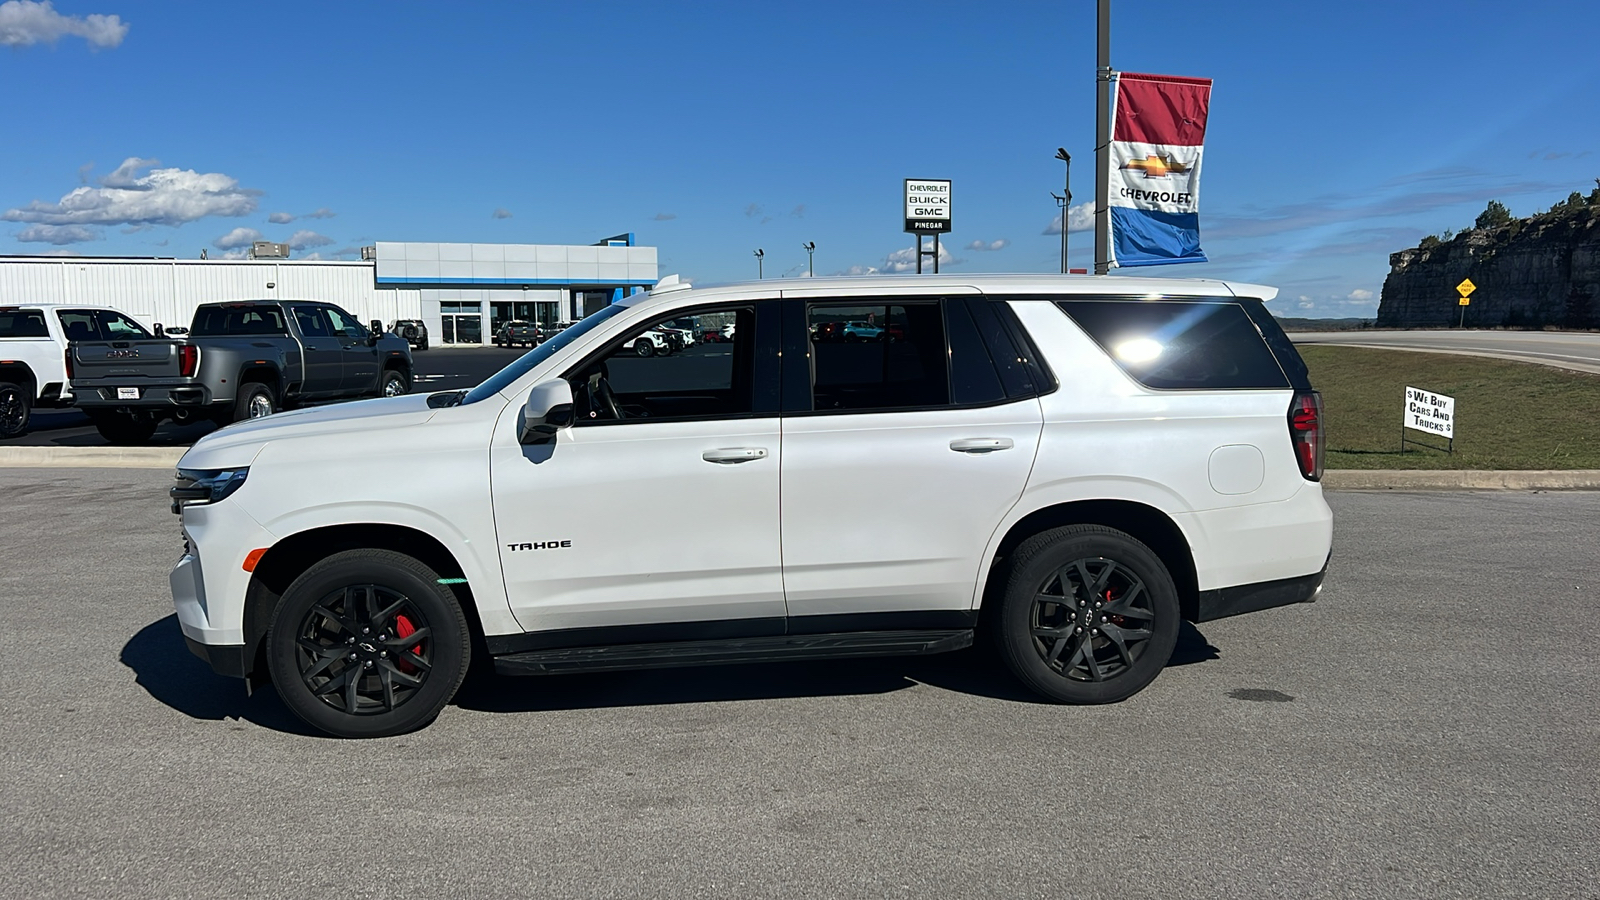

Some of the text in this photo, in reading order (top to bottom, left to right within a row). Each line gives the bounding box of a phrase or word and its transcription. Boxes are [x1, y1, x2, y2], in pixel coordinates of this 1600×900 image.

[909, 184, 947, 192] CHEVROLET
[909, 196, 947, 204] BUICK
[1120, 187, 1190, 203] CHEVROLET
[914, 208, 943, 216] GMC
[1409, 402, 1450, 421] CARS AND
[1414, 415, 1444, 432] TRUCKS
[507, 540, 572, 552] TAHOE
